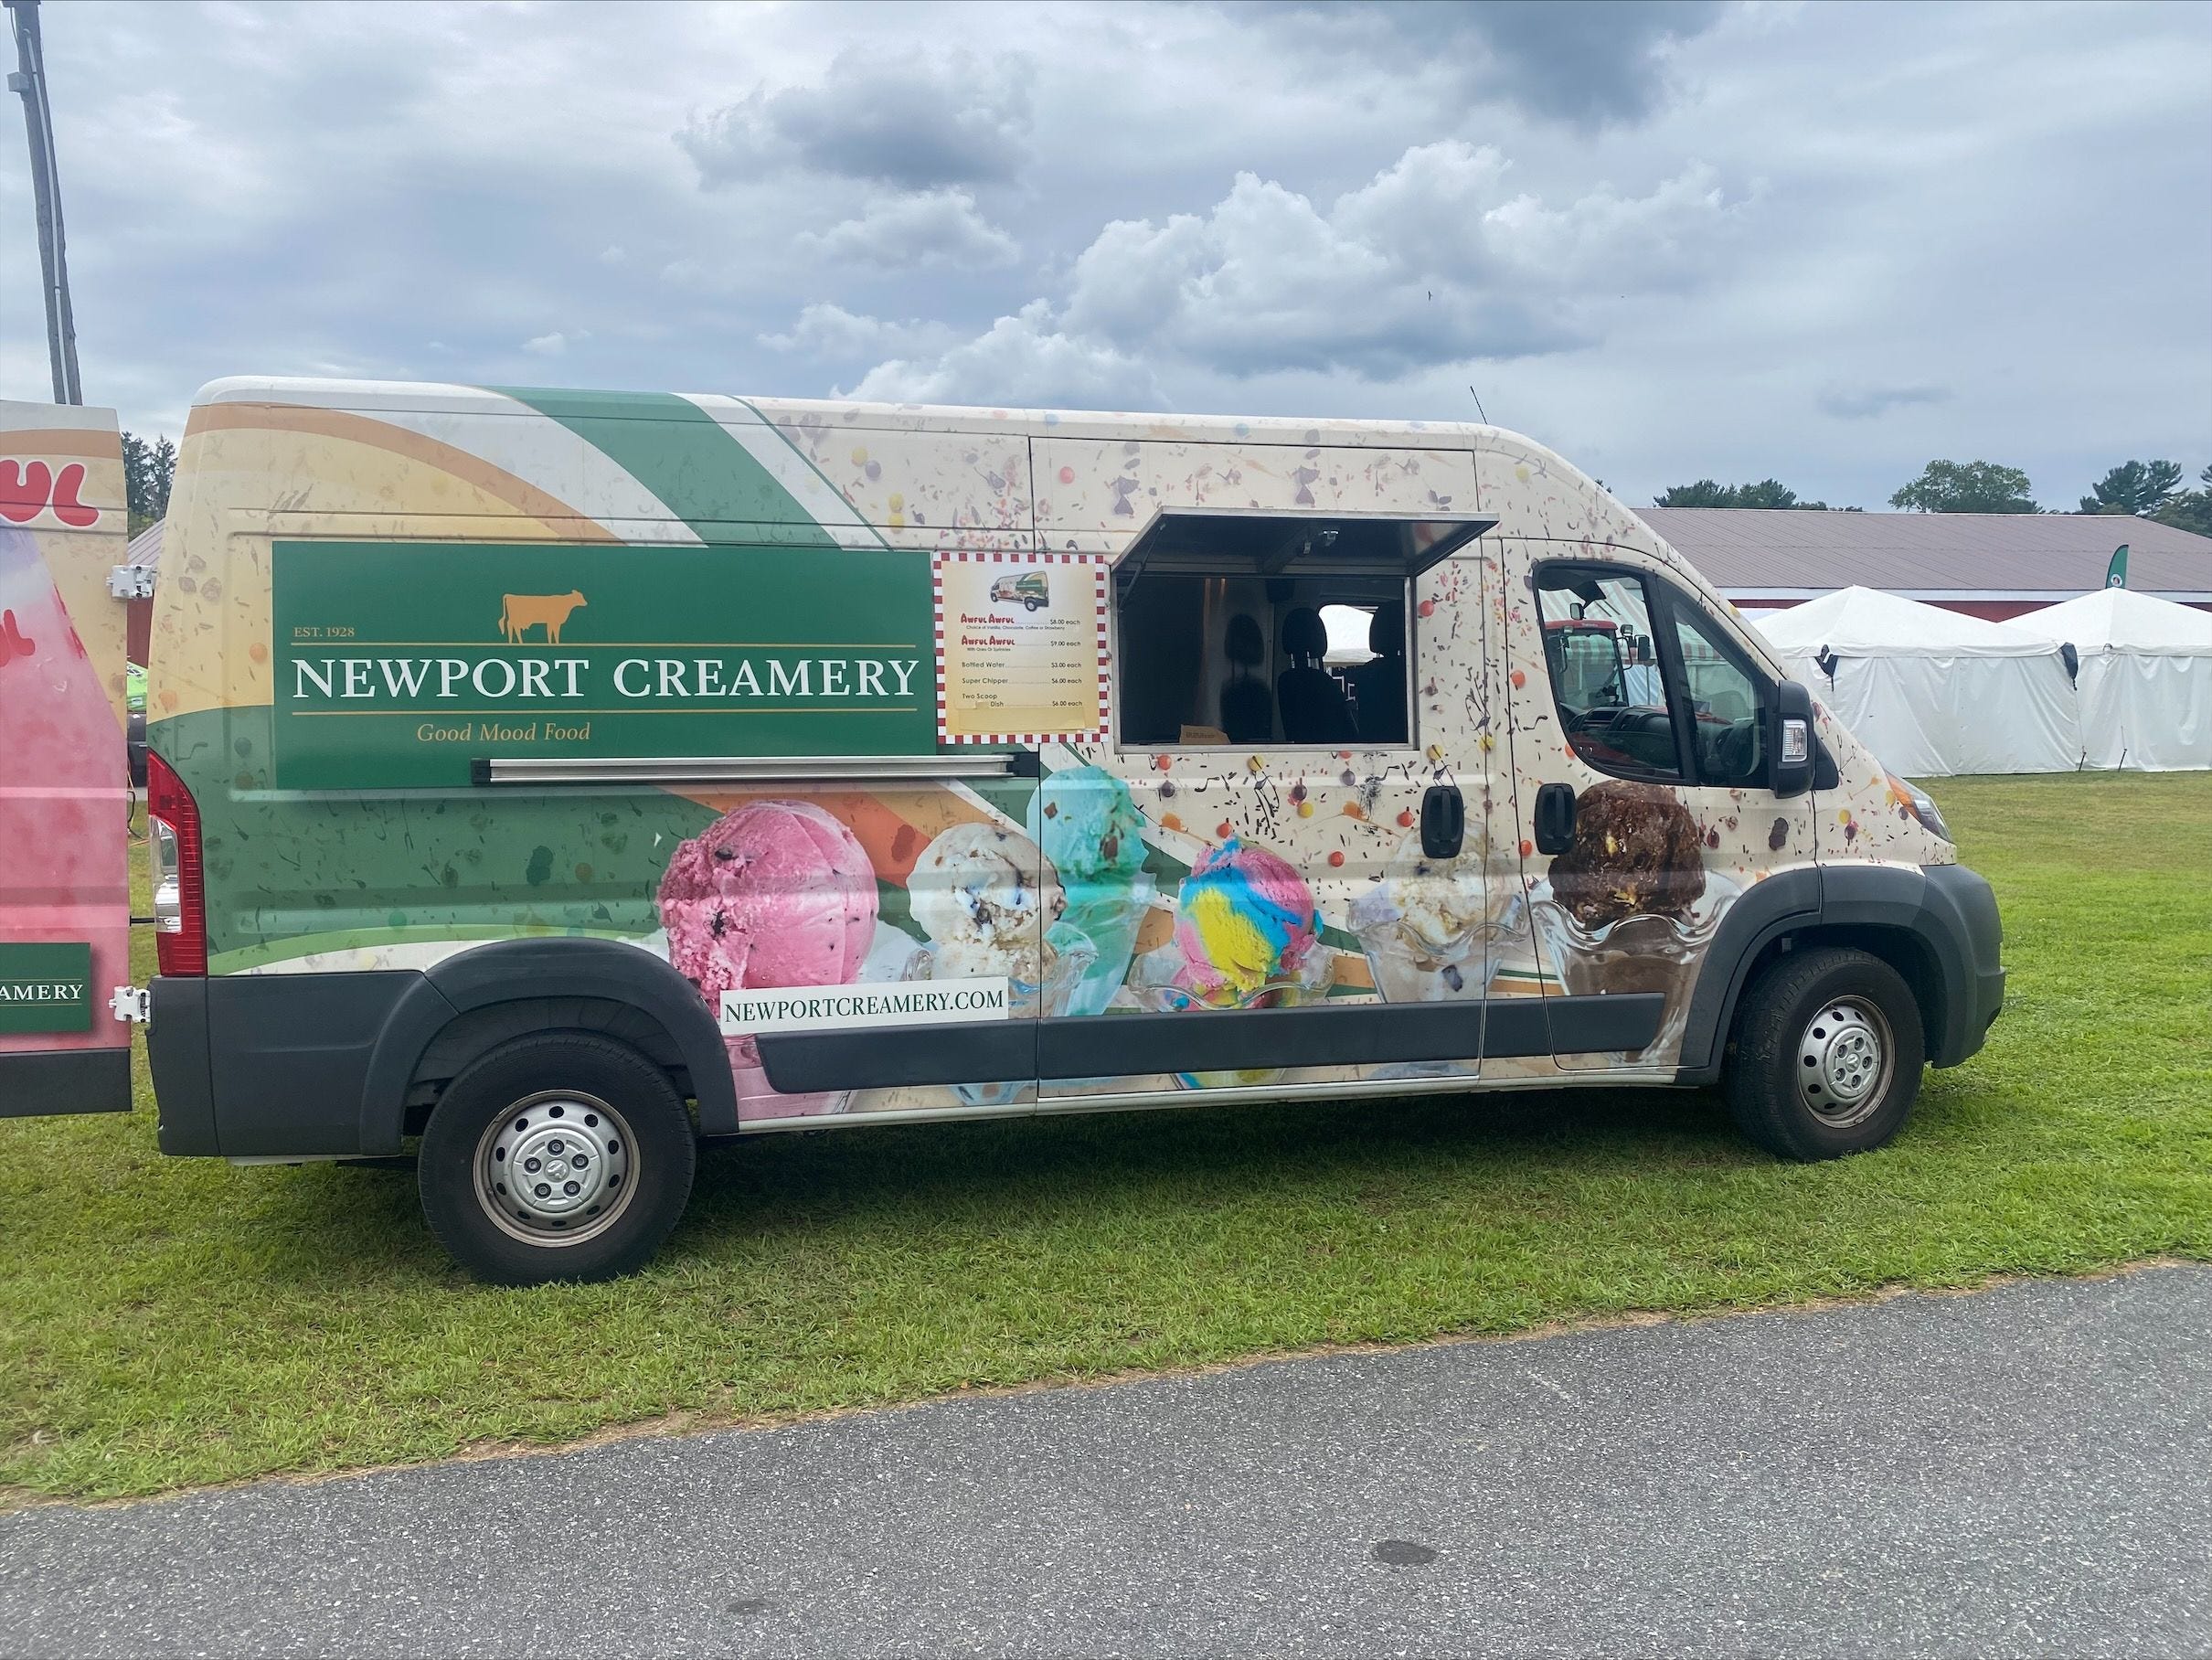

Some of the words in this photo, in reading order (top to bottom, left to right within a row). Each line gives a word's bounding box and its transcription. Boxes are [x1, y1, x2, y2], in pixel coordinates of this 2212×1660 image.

[294, 627, 323, 638] EST.
[326, 627, 355, 638] 1928
[292, 658, 590, 699] NEWPORT
[612, 658, 920, 697] CREAMERY
[962, 677, 981, 686] Super
[983, 677, 1008, 686] Chipper
[976, 693, 998, 701] Scoop
[417, 723, 472, 742] Good
[478, 723, 537, 741] Mood
[543, 722, 591, 740] Food
[724, 990, 1004, 1023] NEWPORTCREAMERY.COM
